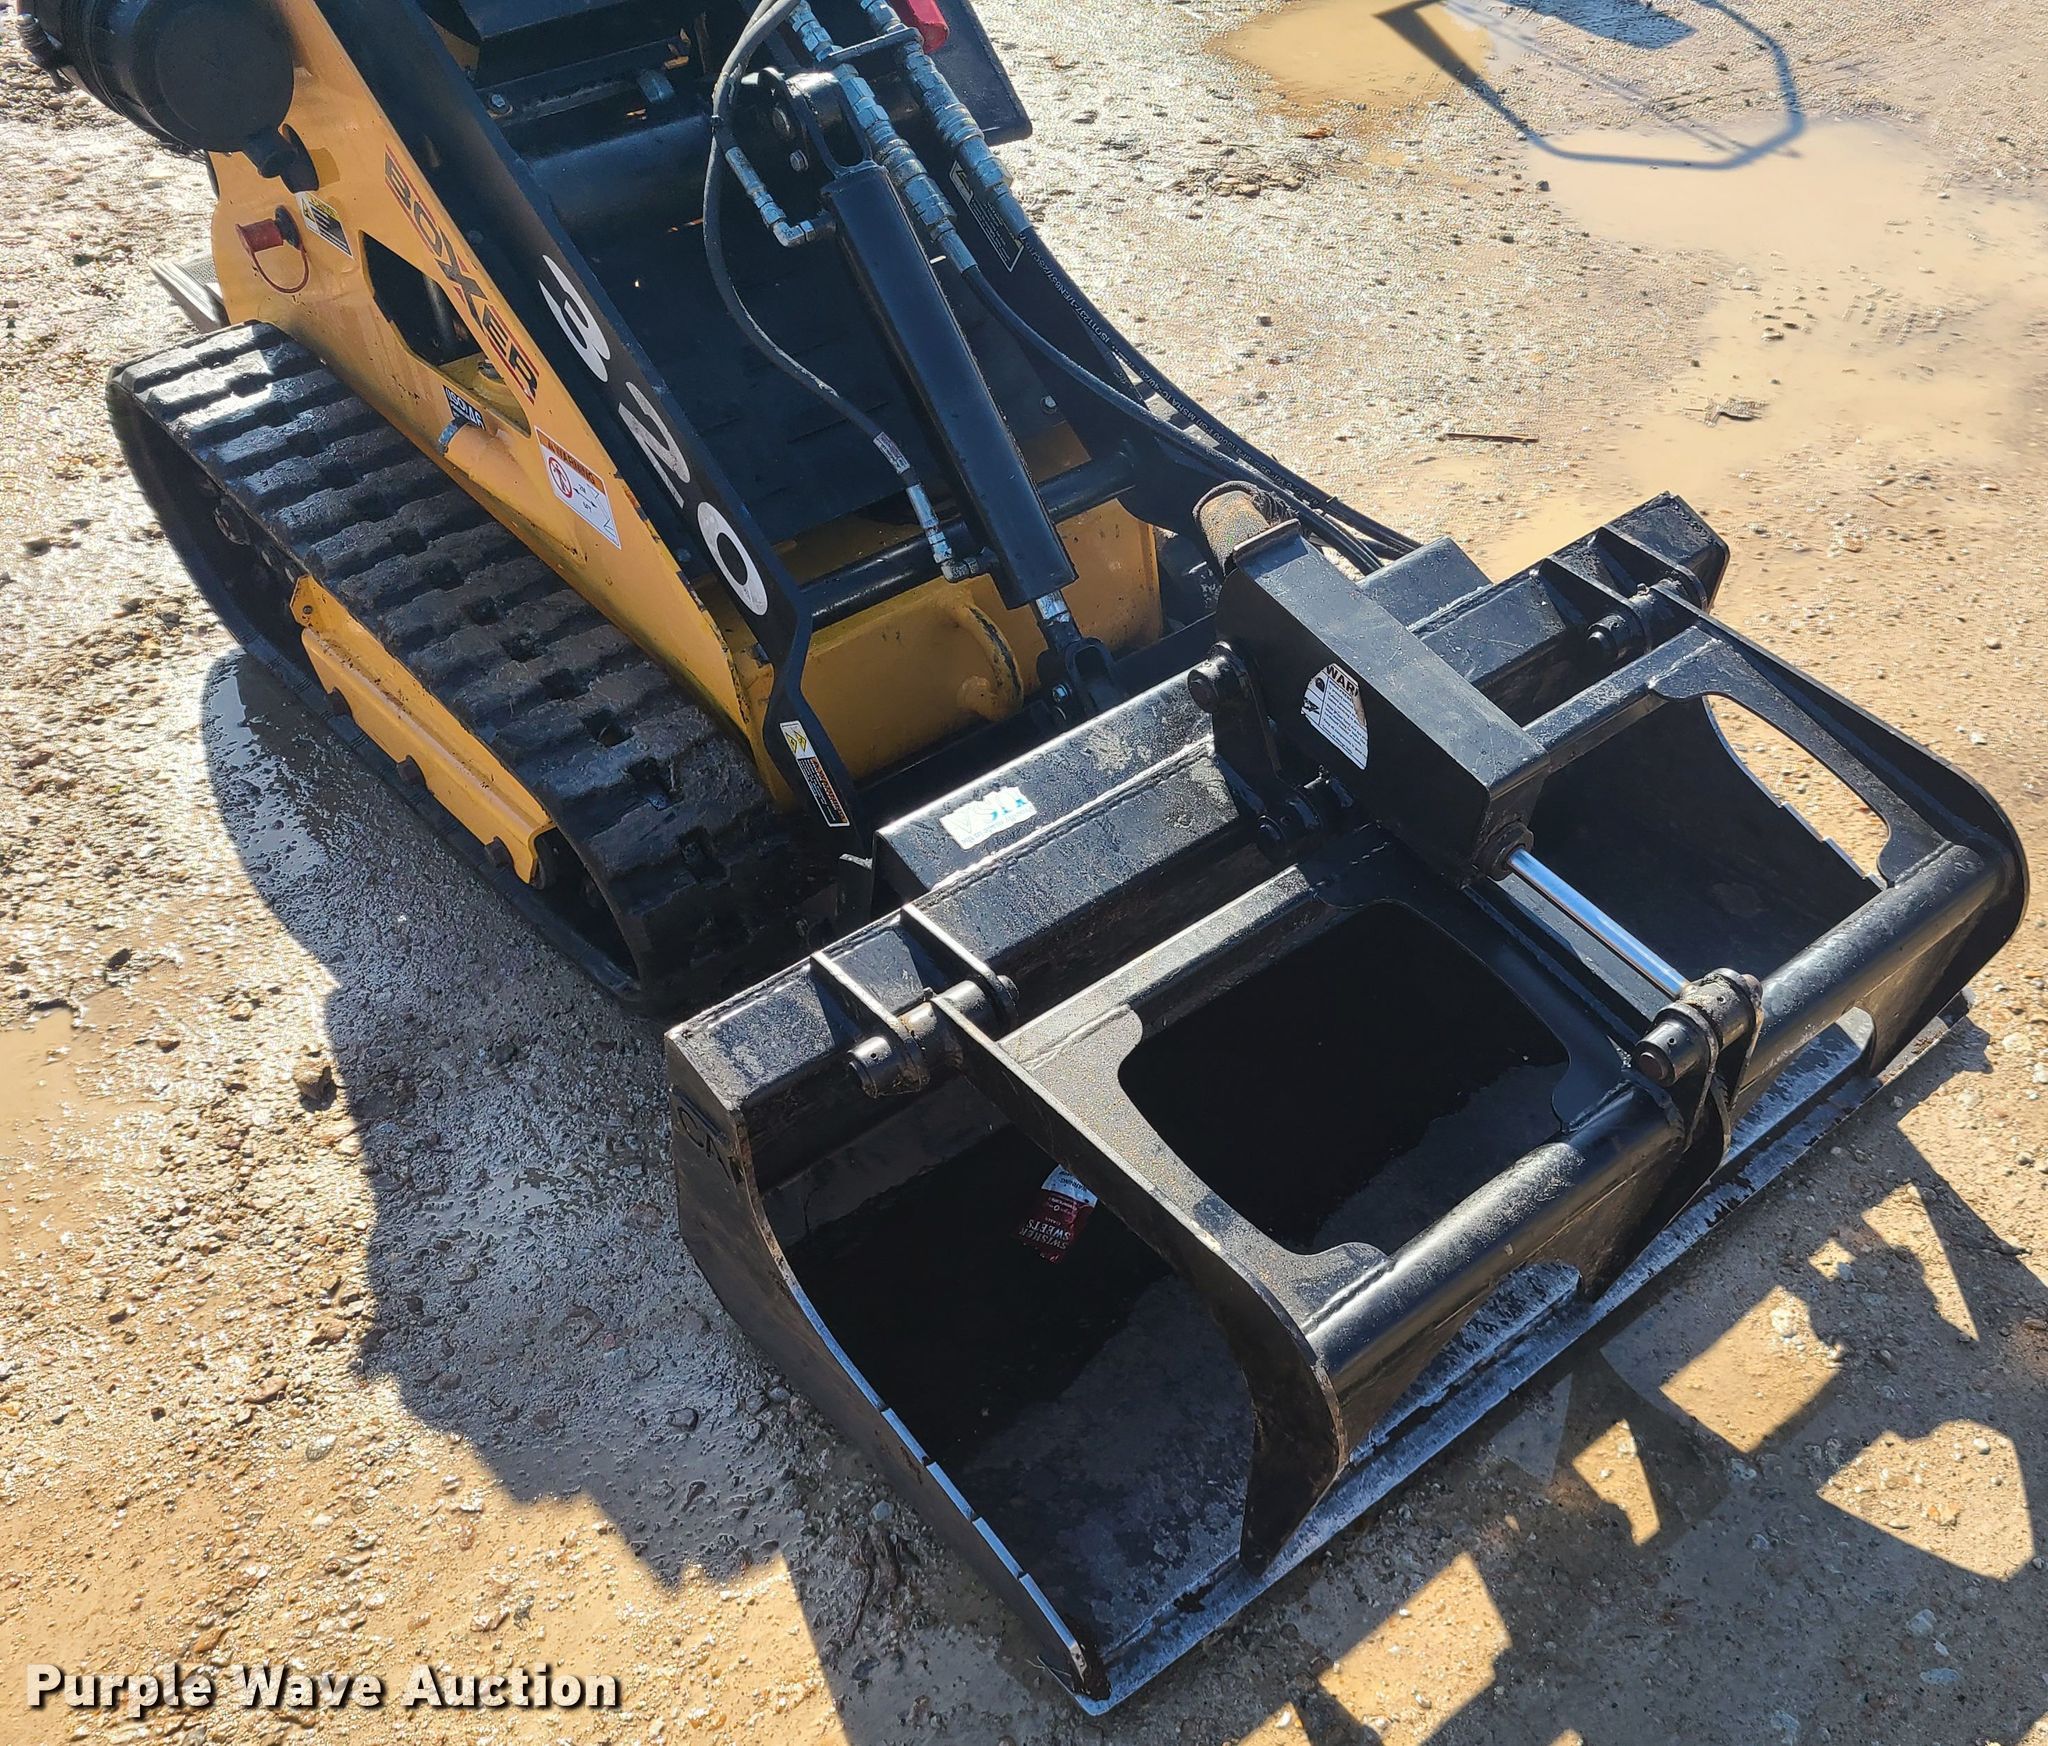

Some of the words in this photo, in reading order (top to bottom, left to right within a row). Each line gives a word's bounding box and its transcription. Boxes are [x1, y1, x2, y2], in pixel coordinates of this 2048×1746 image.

[385, 150, 538, 400] BOXER
[538, 254, 768, 616] 320
[1170, 398, 1196, 420] MSHA
[1027, 1219, 1071, 1241] SWEETS
